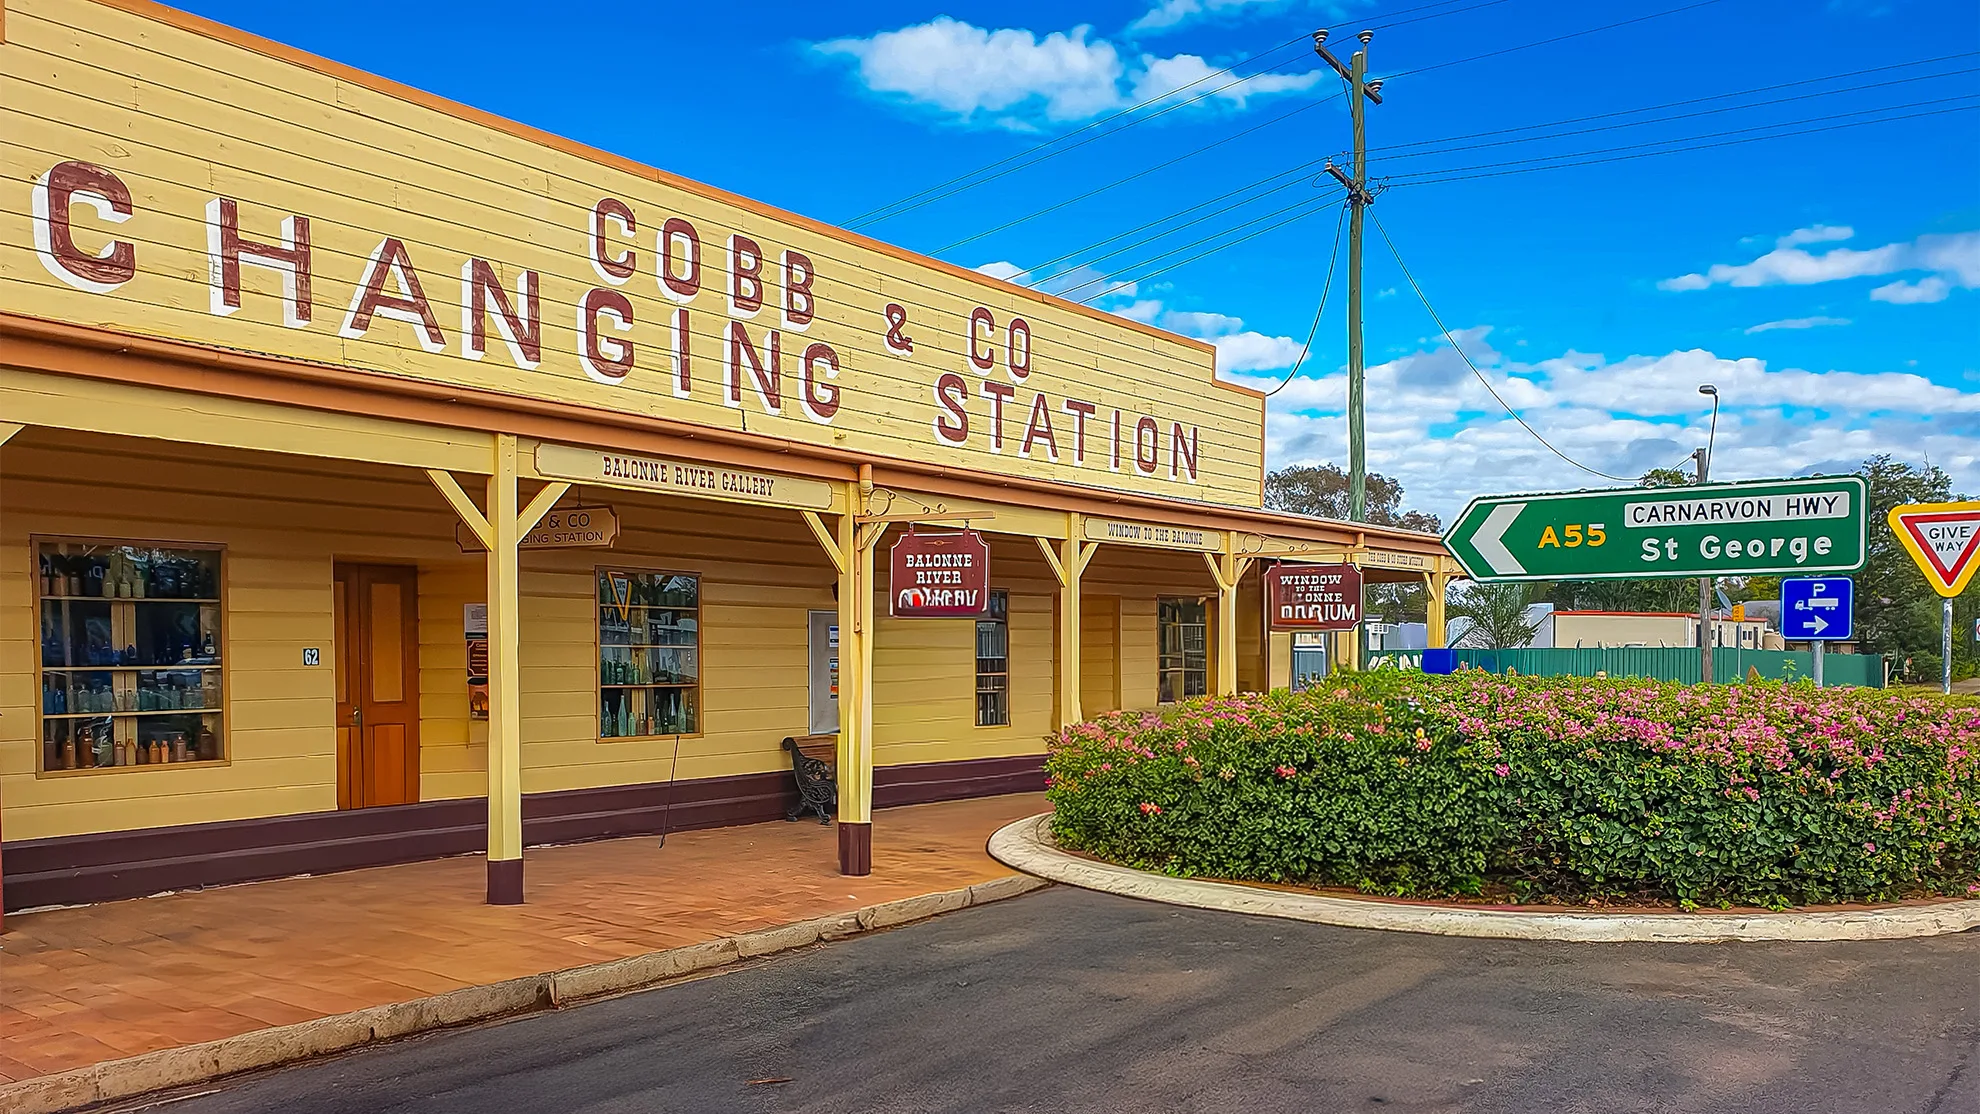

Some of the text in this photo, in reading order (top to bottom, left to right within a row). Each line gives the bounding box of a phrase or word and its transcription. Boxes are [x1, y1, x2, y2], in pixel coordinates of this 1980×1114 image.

[589, 198, 1032, 384] COBB & CO
[31, 160, 1200, 483] CHANGING STATION
[603, 456, 775, 496] BALONNE RIVER GALLERY
[1632, 495, 1840, 524] CARNARVON HWY
[549, 514, 560, 528] &
[567, 513, 590, 528] CO
[522, 531, 604, 544] GING STATION
[1107, 523, 1203, 545] WINDOW TO THE BALONNE
[1538, 523, 1607, 549] A55
[1929, 526, 1971, 539] GIVE
[1640, 535, 1833, 564] St George
[1935, 541, 1964, 552] WAY
[906, 554, 973, 568] BALONNE
[916, 571, 962, 584] RIVER
[1280, 574, 1342, 585] WINDOW
[1813, 583, 1827, 597] P
[305, 649, 318, 665] 62
